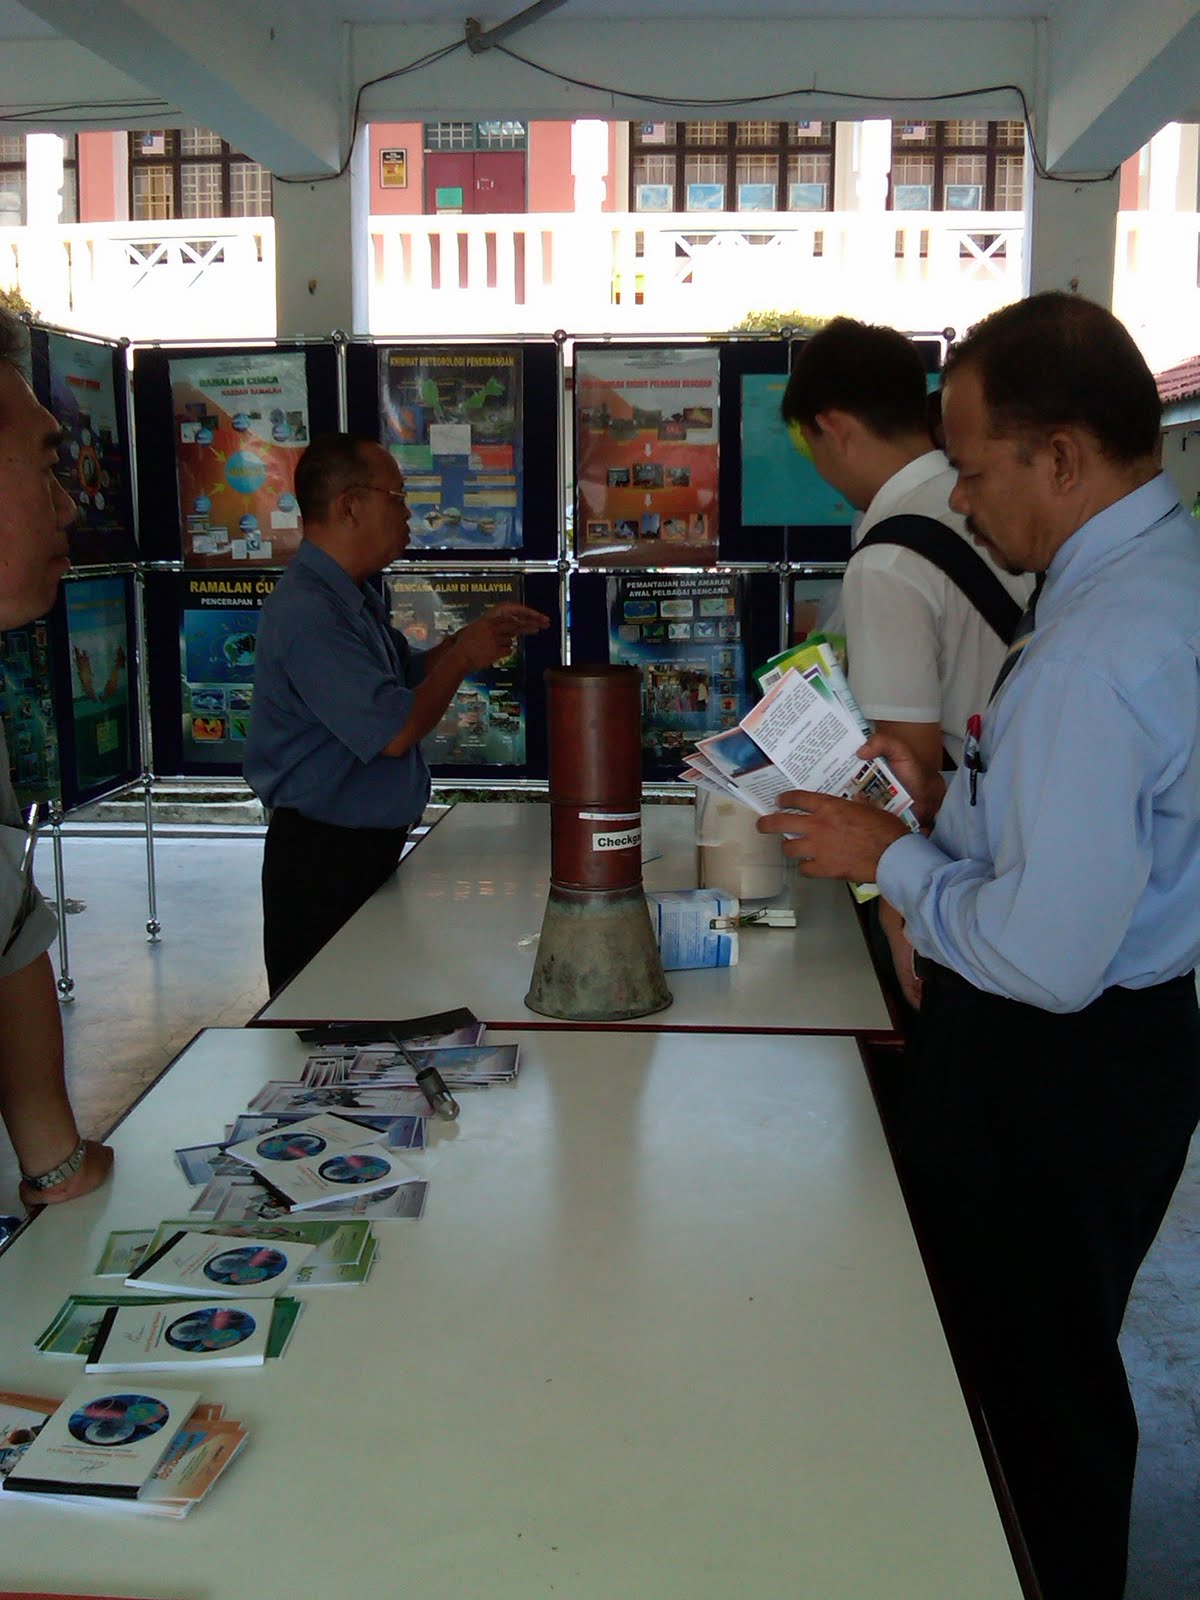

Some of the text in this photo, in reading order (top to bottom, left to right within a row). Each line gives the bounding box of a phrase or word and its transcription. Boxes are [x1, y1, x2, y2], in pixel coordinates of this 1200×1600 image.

[190, 581, 274, 593] RAMALAN CU
[394, 582, 512, 593] BENCANA ALAM DI MALAYSIA
[626, 578, 730, 589] PEMANTAUAN DAN AMARAN
[629, 587, 729, 598] AWAL PELBAGAI BENCANA
